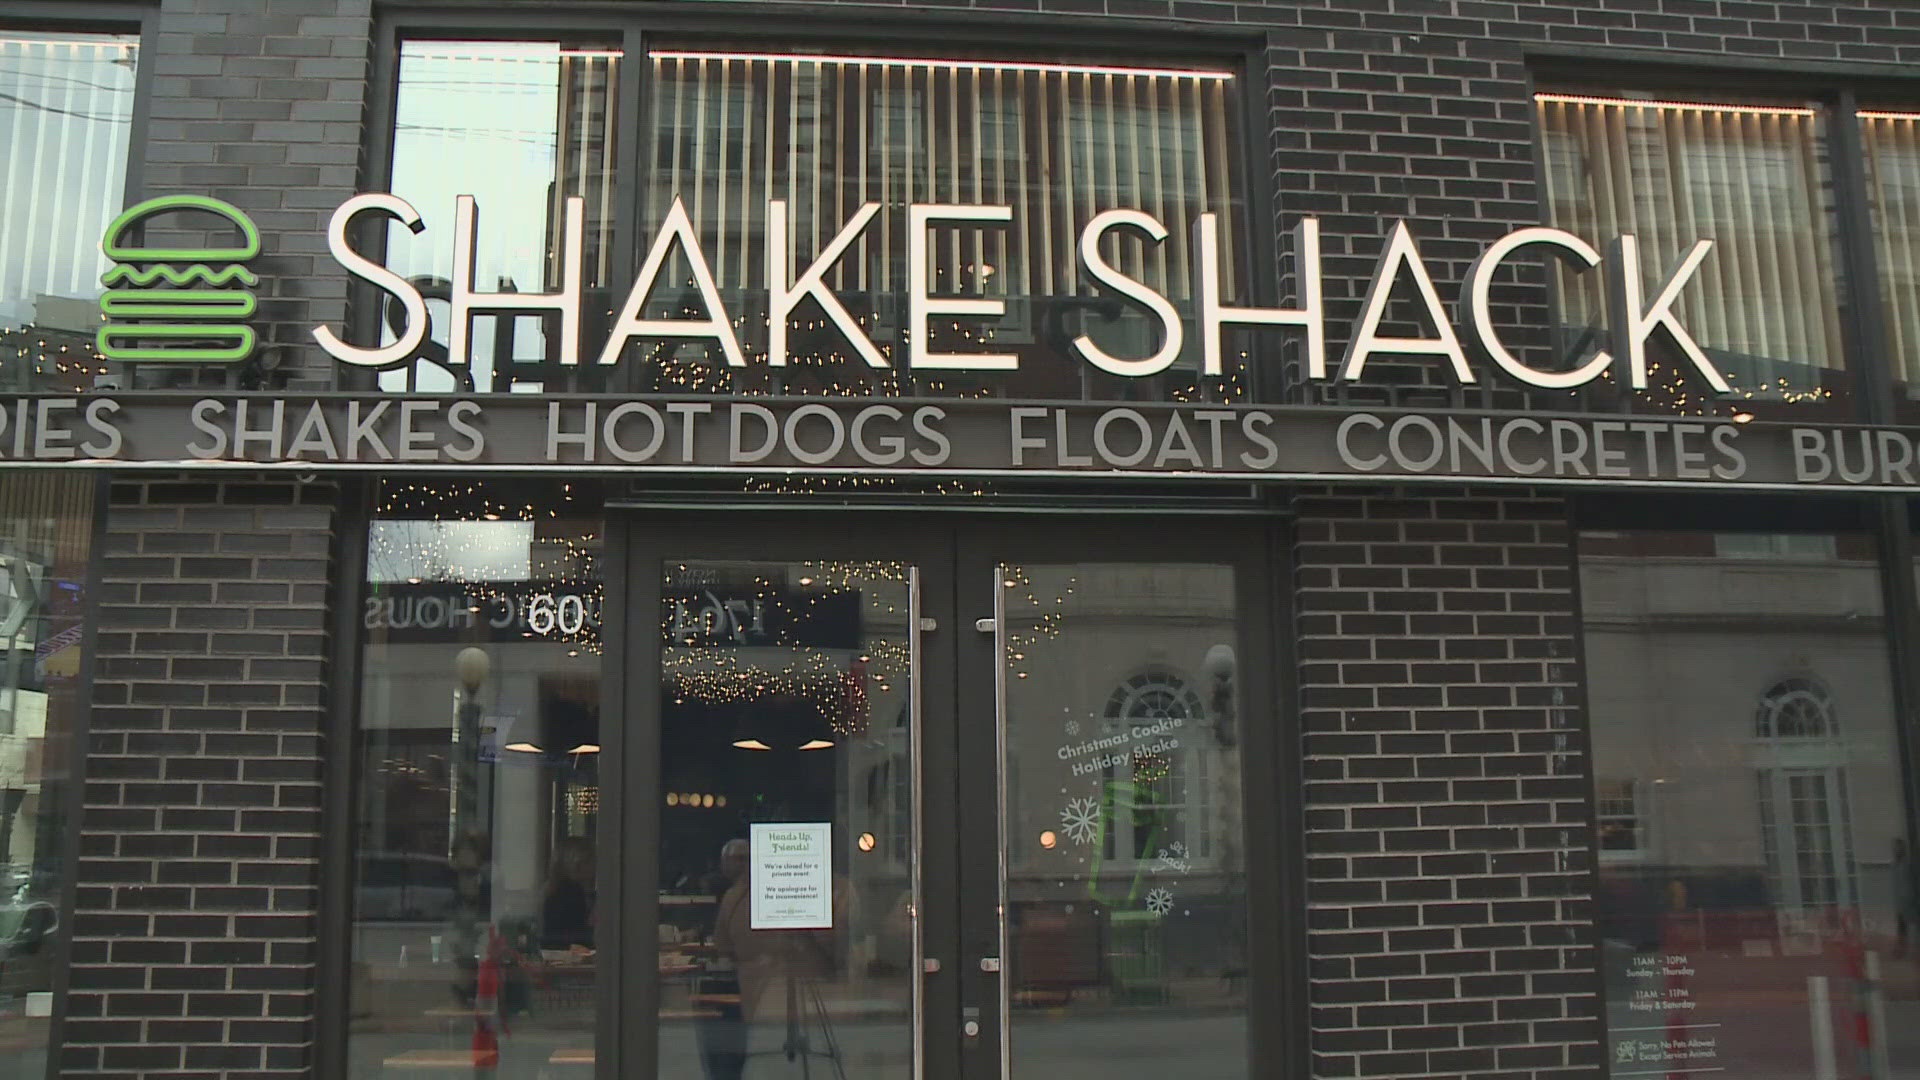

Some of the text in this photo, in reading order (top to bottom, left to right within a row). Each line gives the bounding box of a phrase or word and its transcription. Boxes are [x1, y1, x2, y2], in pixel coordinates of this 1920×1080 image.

[311, 193, 1731, 395] SHAKE SHACK
[186, 399, 484, 461] SHAKES
[546, 401, 712, 464] HOT
[729, 403, 951, 465] DOGS
[1010, 406, 1278, 470] FLOATS
[1336, 413, 1747, 479] CONCRETES
[1793, 427, 1920, 484] BUR
[529, 594, 584, 635] 60
[1057, 717, 1183, 760] Christmas Cookie
[1071, 738, 1180, 777] Holiday Shake
[1158, 848, 1192, 875] Back!
[1626, 968, 1654, 978] Sunday
[1662, 966, 1695, 977] Thursday
[1632, 957, 1655, 966] 11AM
[1666, 955, 1688, 965] 10PM
[1629, 1000, 1696, 1012] Friday & Saturday
[1635, 990, 1658, 999] 11AM
[1668, 989, 1689, 998] 11PM
